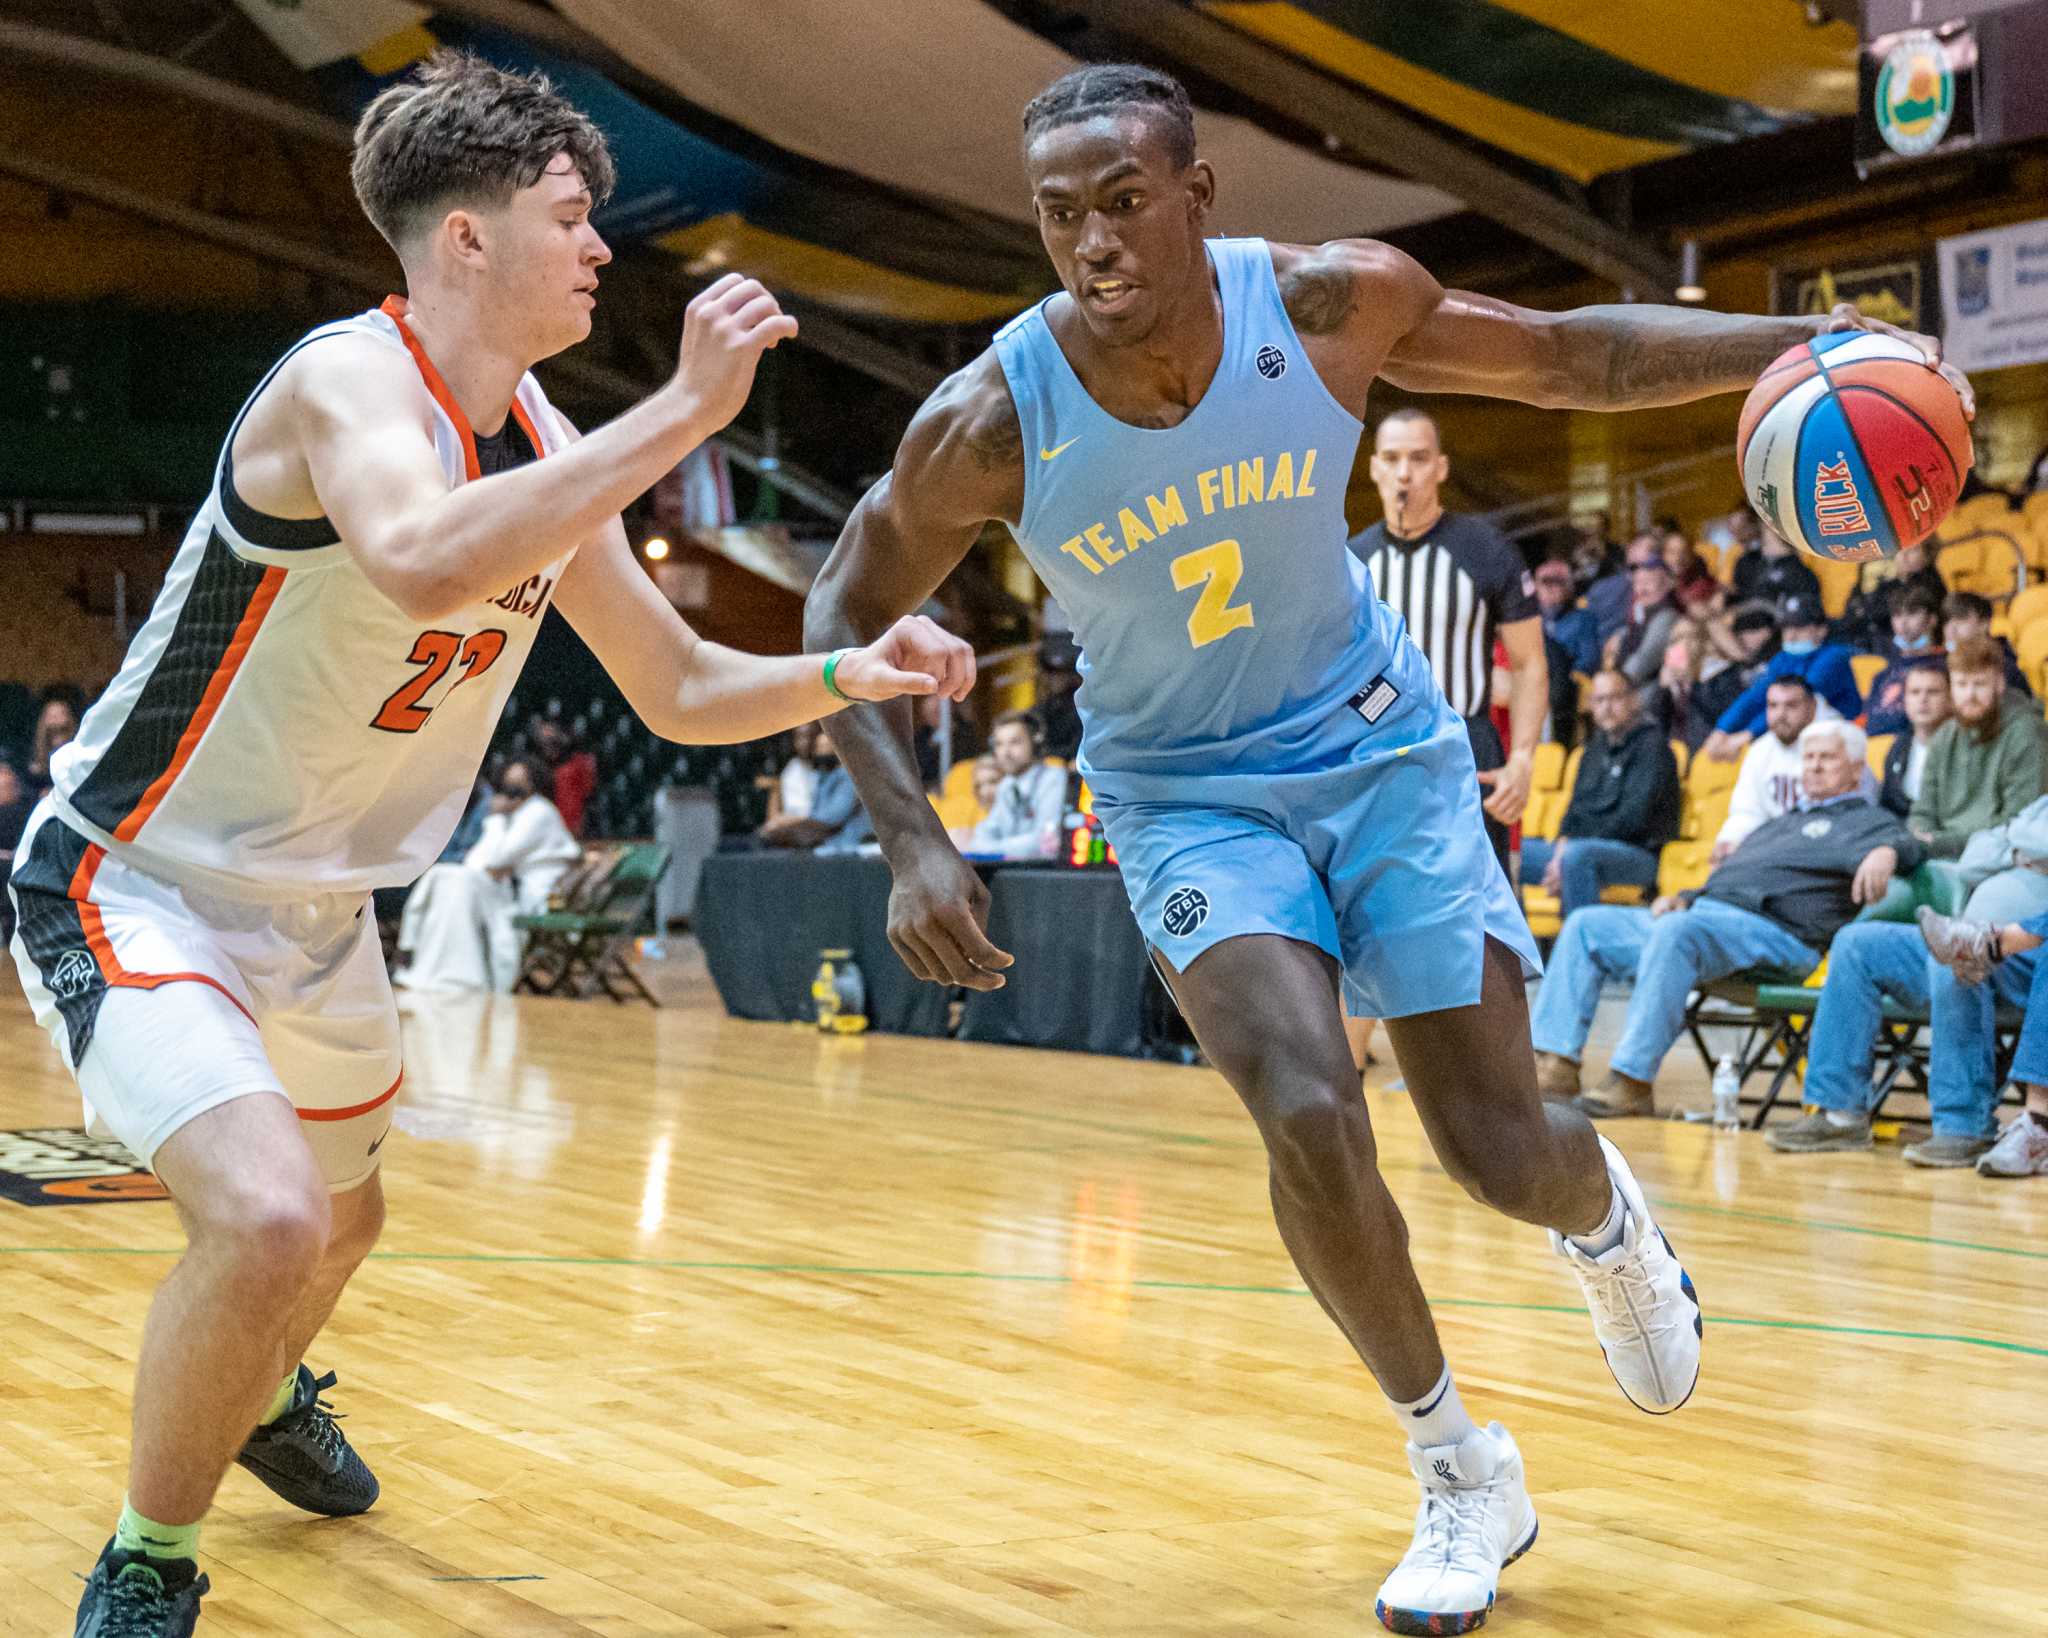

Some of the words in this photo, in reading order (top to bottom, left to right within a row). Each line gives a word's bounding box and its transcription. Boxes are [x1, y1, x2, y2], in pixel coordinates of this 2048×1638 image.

[1259, 352, 1283, 367] EYBL
[1059, 484, 1190, 576] TEAM
[1196, 447, 1318, 516] FINAL
[1169, 538, 1255, 650] 2
[1165, 894, 1202, 925] EYBL
